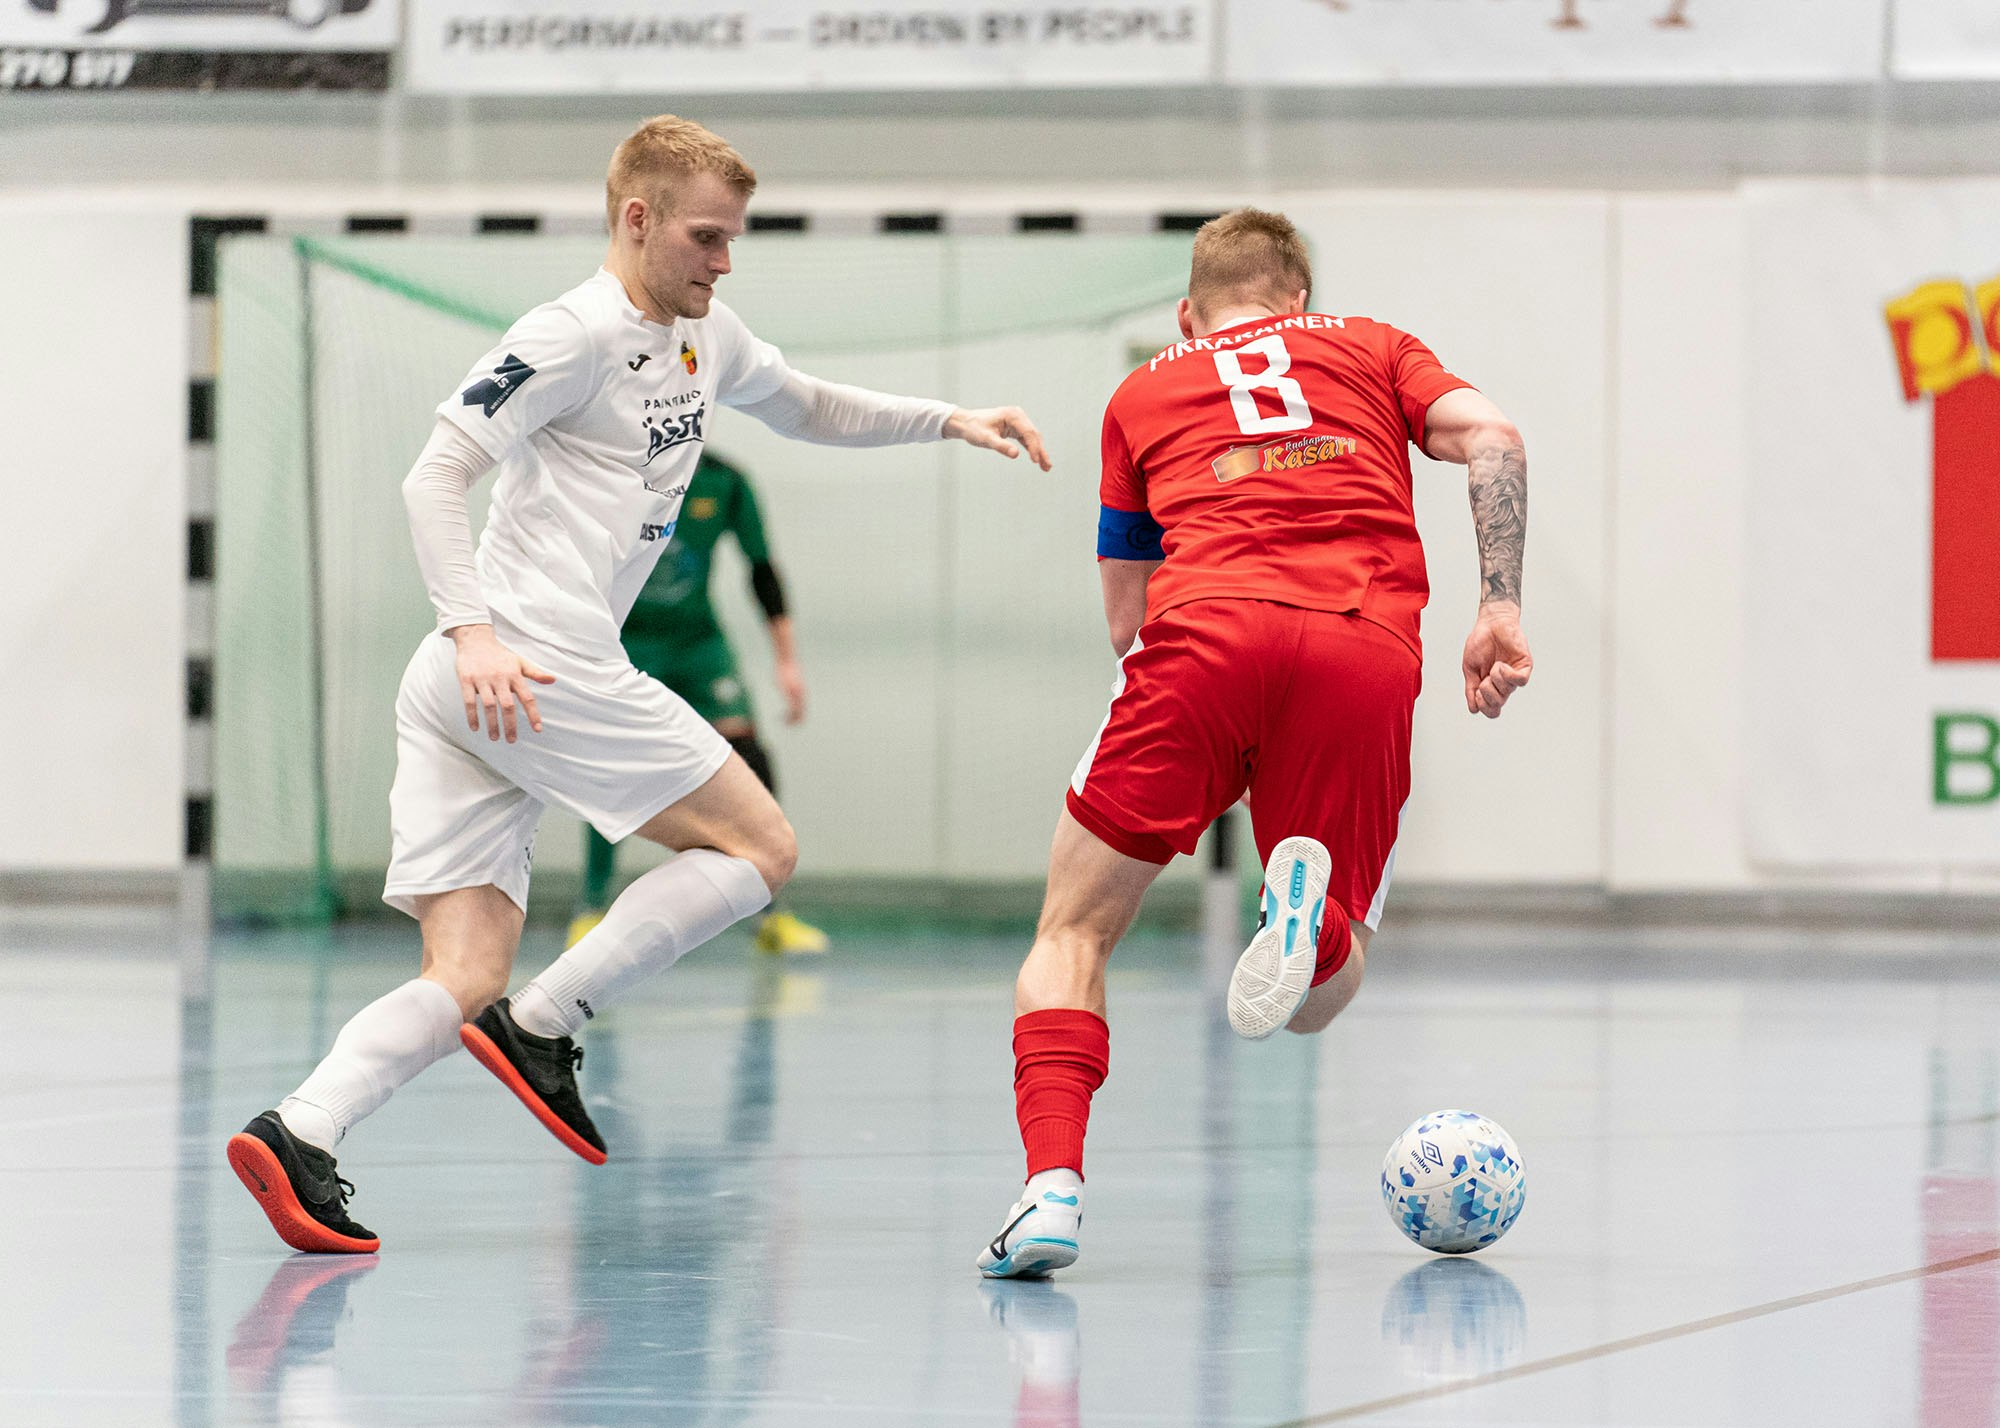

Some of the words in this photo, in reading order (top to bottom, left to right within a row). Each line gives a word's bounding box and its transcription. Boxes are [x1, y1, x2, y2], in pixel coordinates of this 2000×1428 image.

[442, 14, 748, 51] PERFORMANCE
[811, 11, 967, 46] DRIVEN
[979, 9, 1034, 45] BY
[1041, 6, 1197, 45] PEOPLE
[1150, 316, 1347, 373] PIKKARAINEN
[1212, 335, 1314, 436] 8
[1411, 1150, 1431, 1174] umbro
